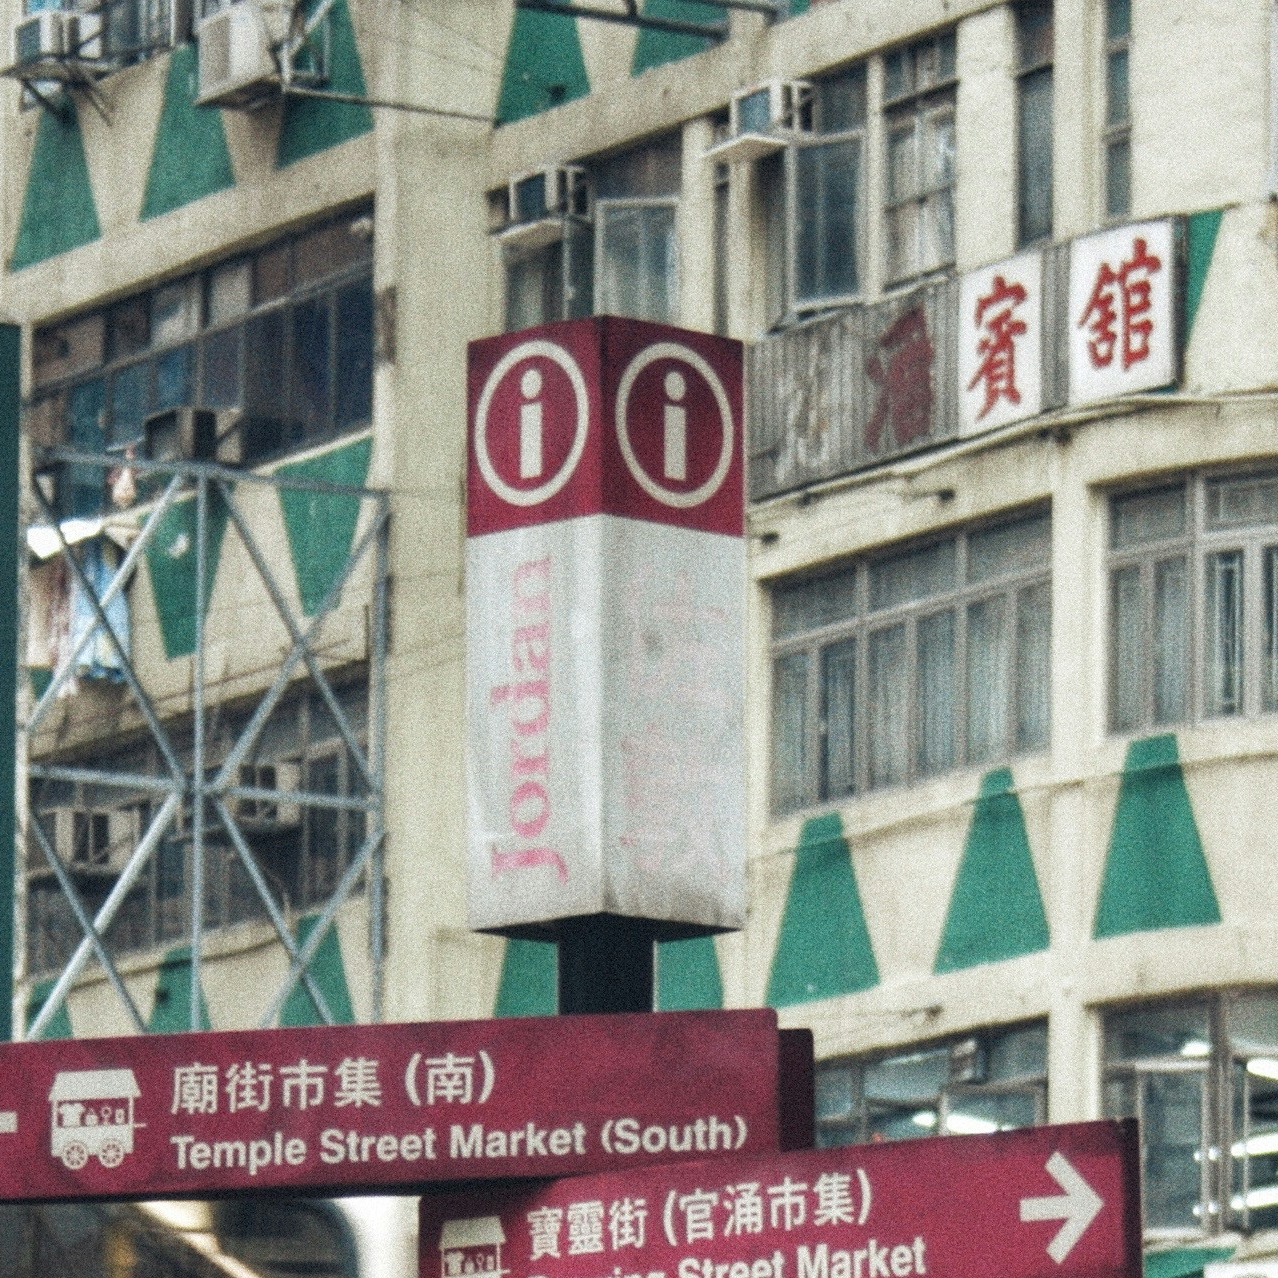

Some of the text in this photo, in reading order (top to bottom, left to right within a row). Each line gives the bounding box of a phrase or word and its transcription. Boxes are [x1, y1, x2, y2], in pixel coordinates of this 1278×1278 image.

[975, 237, 1163, 413] 賓館
[169, 1112, 748, 1177] Temple Street Market (South)
